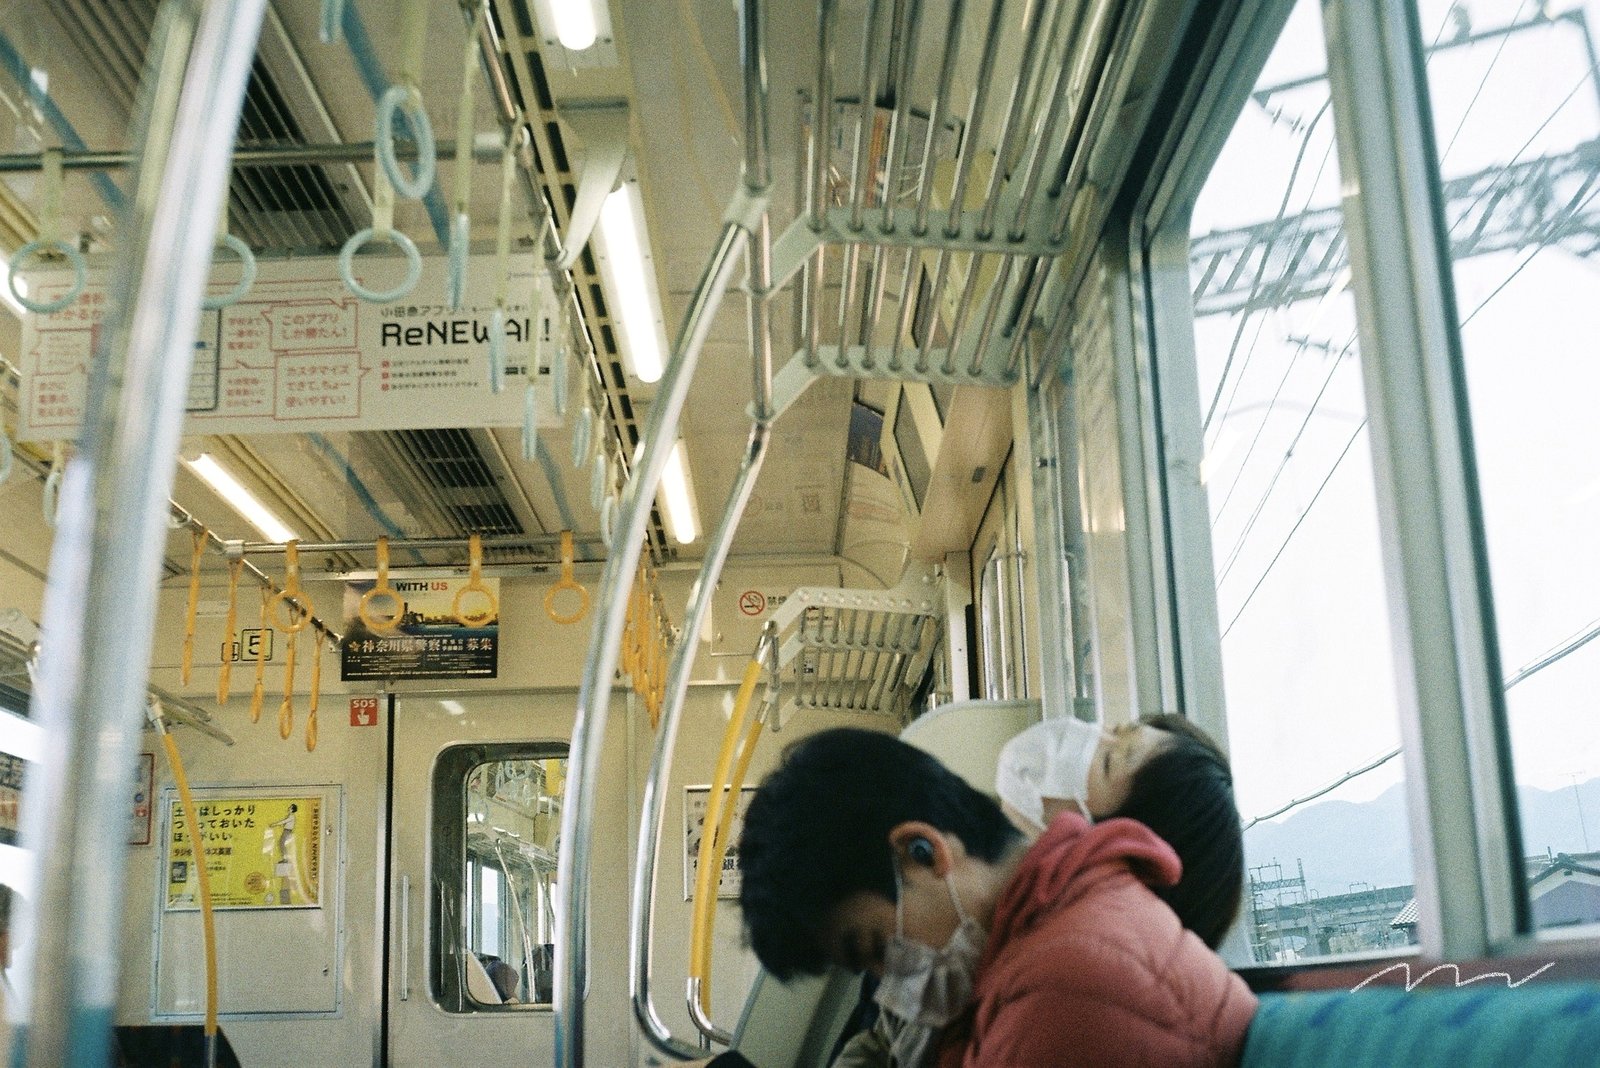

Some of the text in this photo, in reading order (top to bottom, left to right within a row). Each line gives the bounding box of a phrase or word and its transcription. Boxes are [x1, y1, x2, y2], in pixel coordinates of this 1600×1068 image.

[396, 581, 448, 592] WITH US
[352, 699, 376, 708] SOS
[174, 804, 255, 817] 土はしっかり
[174, 817, 255, 829] つっておいた
